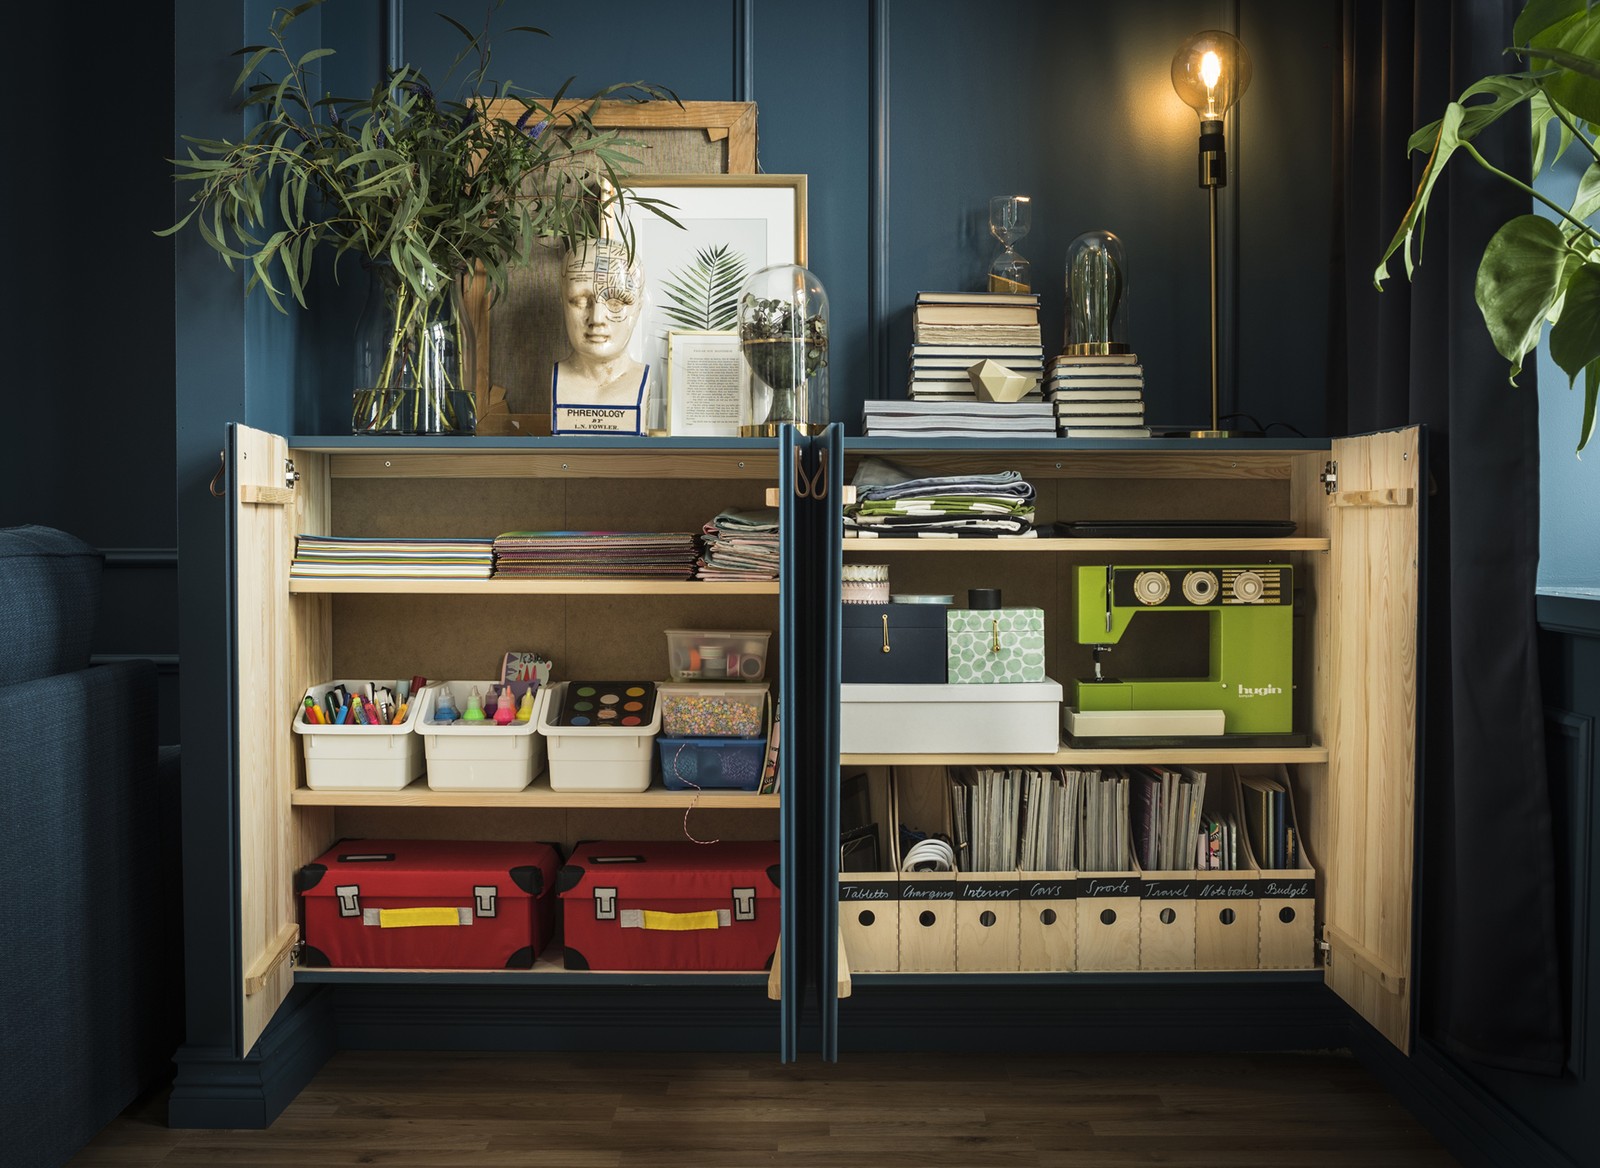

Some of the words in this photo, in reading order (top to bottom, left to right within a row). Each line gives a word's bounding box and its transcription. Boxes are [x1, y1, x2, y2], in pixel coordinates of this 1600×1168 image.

[567, 409, 625, 418] PHRENOLOGY
[1238, 684, 1282, 696] hugin
[963, 884, 1019, 898] Interior
[1030, 882, 1062, 897] Cars
[1086, 880, 1130, 897] Sports
[1145, 882, 1190, 898] Travel
[1264, 882, 1309, 898] Budget
